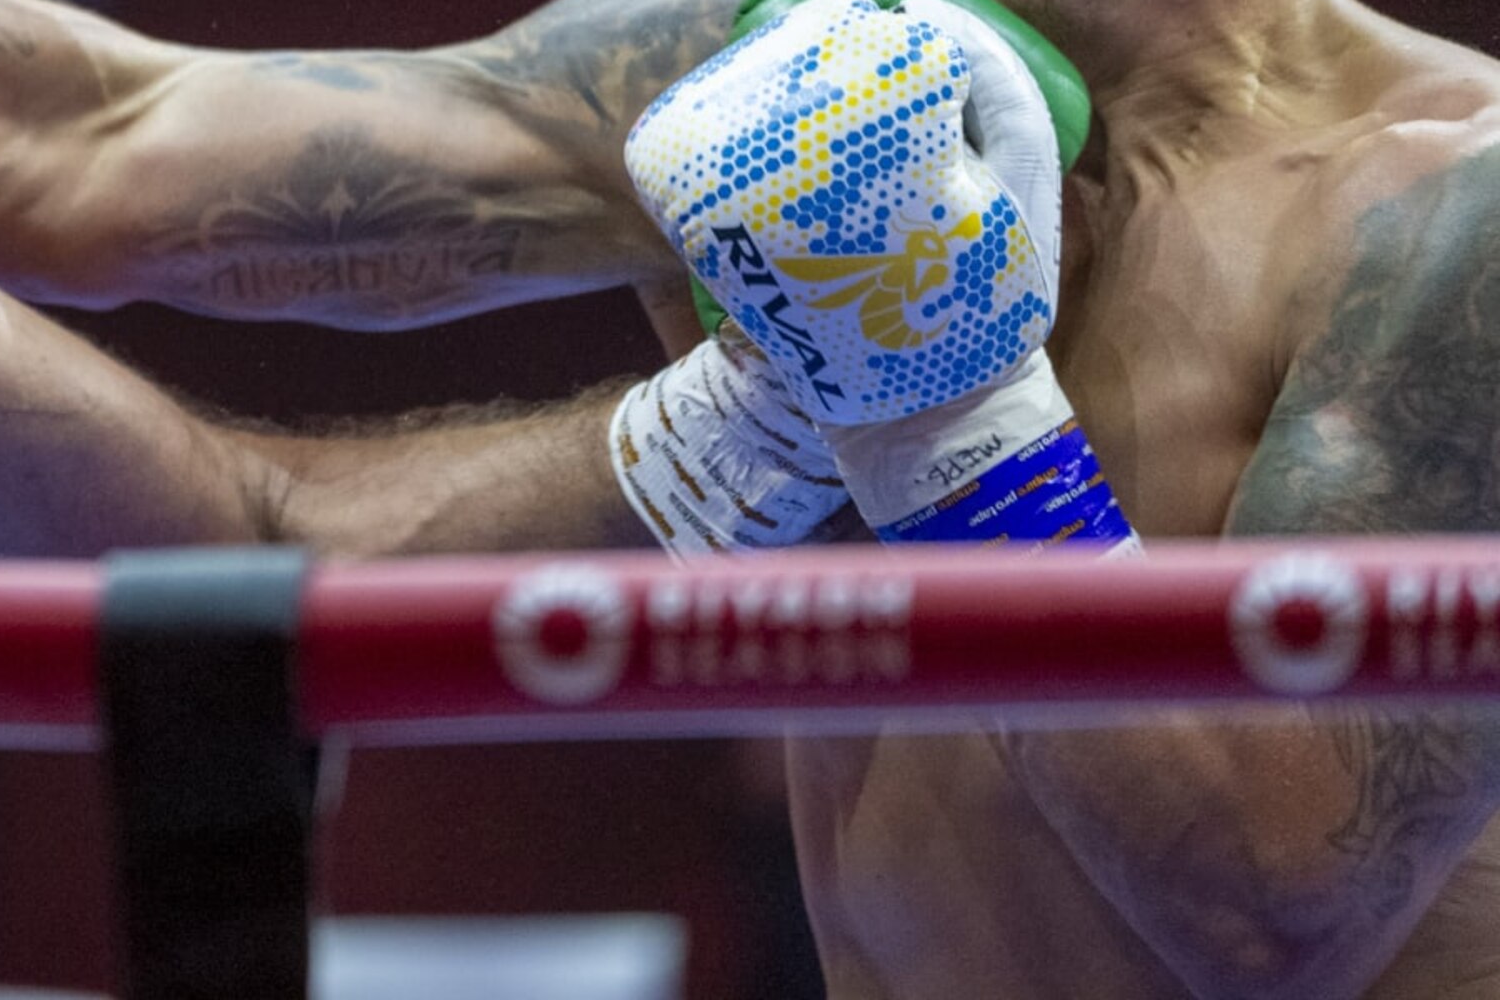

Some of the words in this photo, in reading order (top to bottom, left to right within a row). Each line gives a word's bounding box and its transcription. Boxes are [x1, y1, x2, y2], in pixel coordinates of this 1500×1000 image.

[711, 222, 846, 414] RIVAL
[1016, 466, 1060, 498] empire
[649, 572, 912, 628] RIYADH
